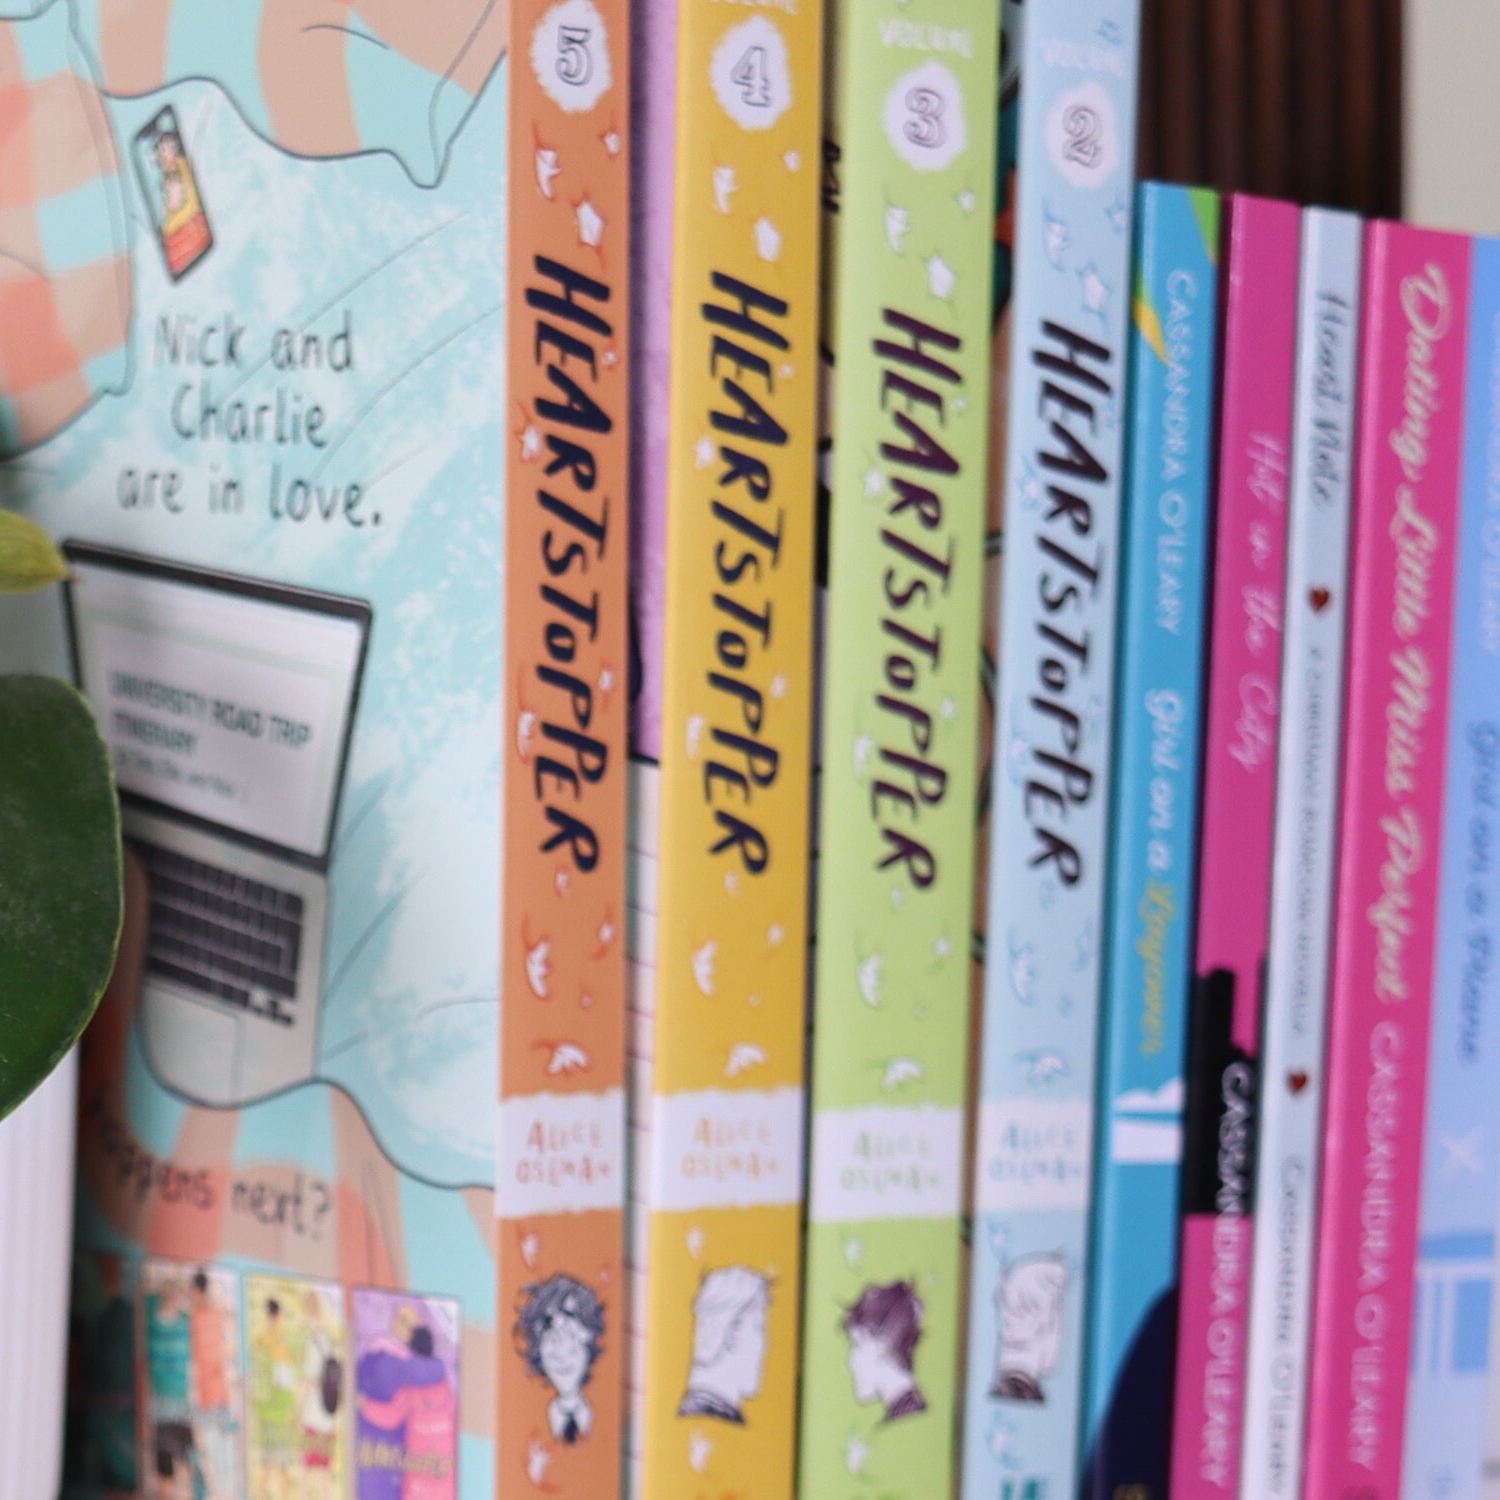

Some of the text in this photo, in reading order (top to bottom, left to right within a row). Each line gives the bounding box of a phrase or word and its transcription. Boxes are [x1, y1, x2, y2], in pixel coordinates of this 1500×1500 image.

[556, 25, 591, 86] 5
[730, 46, 772, 108] 4
[904, 87, 946, 149] 3
[1061, 104, 1103, 169] 2
[154, 310, 356, 372] Nick and
[170, 382, 328, 447] Charlie
[1309, 290, 1352, 511] Heart Note
[1155, 268, 1197, 636] CASSANDRA O'LEARY
[1243, 430, 1288, 513] Hot
[117, 465, 383, 528] are in love.
[523, 253, 613, 875] HEARTSTOPPER
[701, 268, 791, 876] HEARTSTOPPER
[871, 306, 964, 891] HEARTSTOPPER
[1025, 317, 1113, 890] HEARTSTOPPER
[1240, 583, 1282, 656] the
[1366, 261, 1454, 1004] Dating Little Miss Perfect
[212, 698, 265, 739] ROAD
[268, 714, 314, 750] TRIP
[1143, 689, 1184, 771] Girl
[1228, 672, 1278, 774] City
[1148, 777, 1178, 832] on
[1147, 839, 1174, 873] a
[526, 1119, 602, 1153] ALICE
[691, 1115, 771, 1146] ALICE
[852, 1129, 932, 1161] ALICE
[999, 1121, 1078, 1153] ALICE
[1357, 1020, 1402, 1291] CASSANDRA
[515, 1153, 613, 1187] OSEMAN
[680, 1149, 780, 1182] OSEMAN
[840, 1162, 939, 1194] OSEMAN
[987, 1153, 1085, 1185] OSEMAN
[1208, 1062, 1253, 1315] CASSANDRA
[231, 1172, 331, 1241] next?
